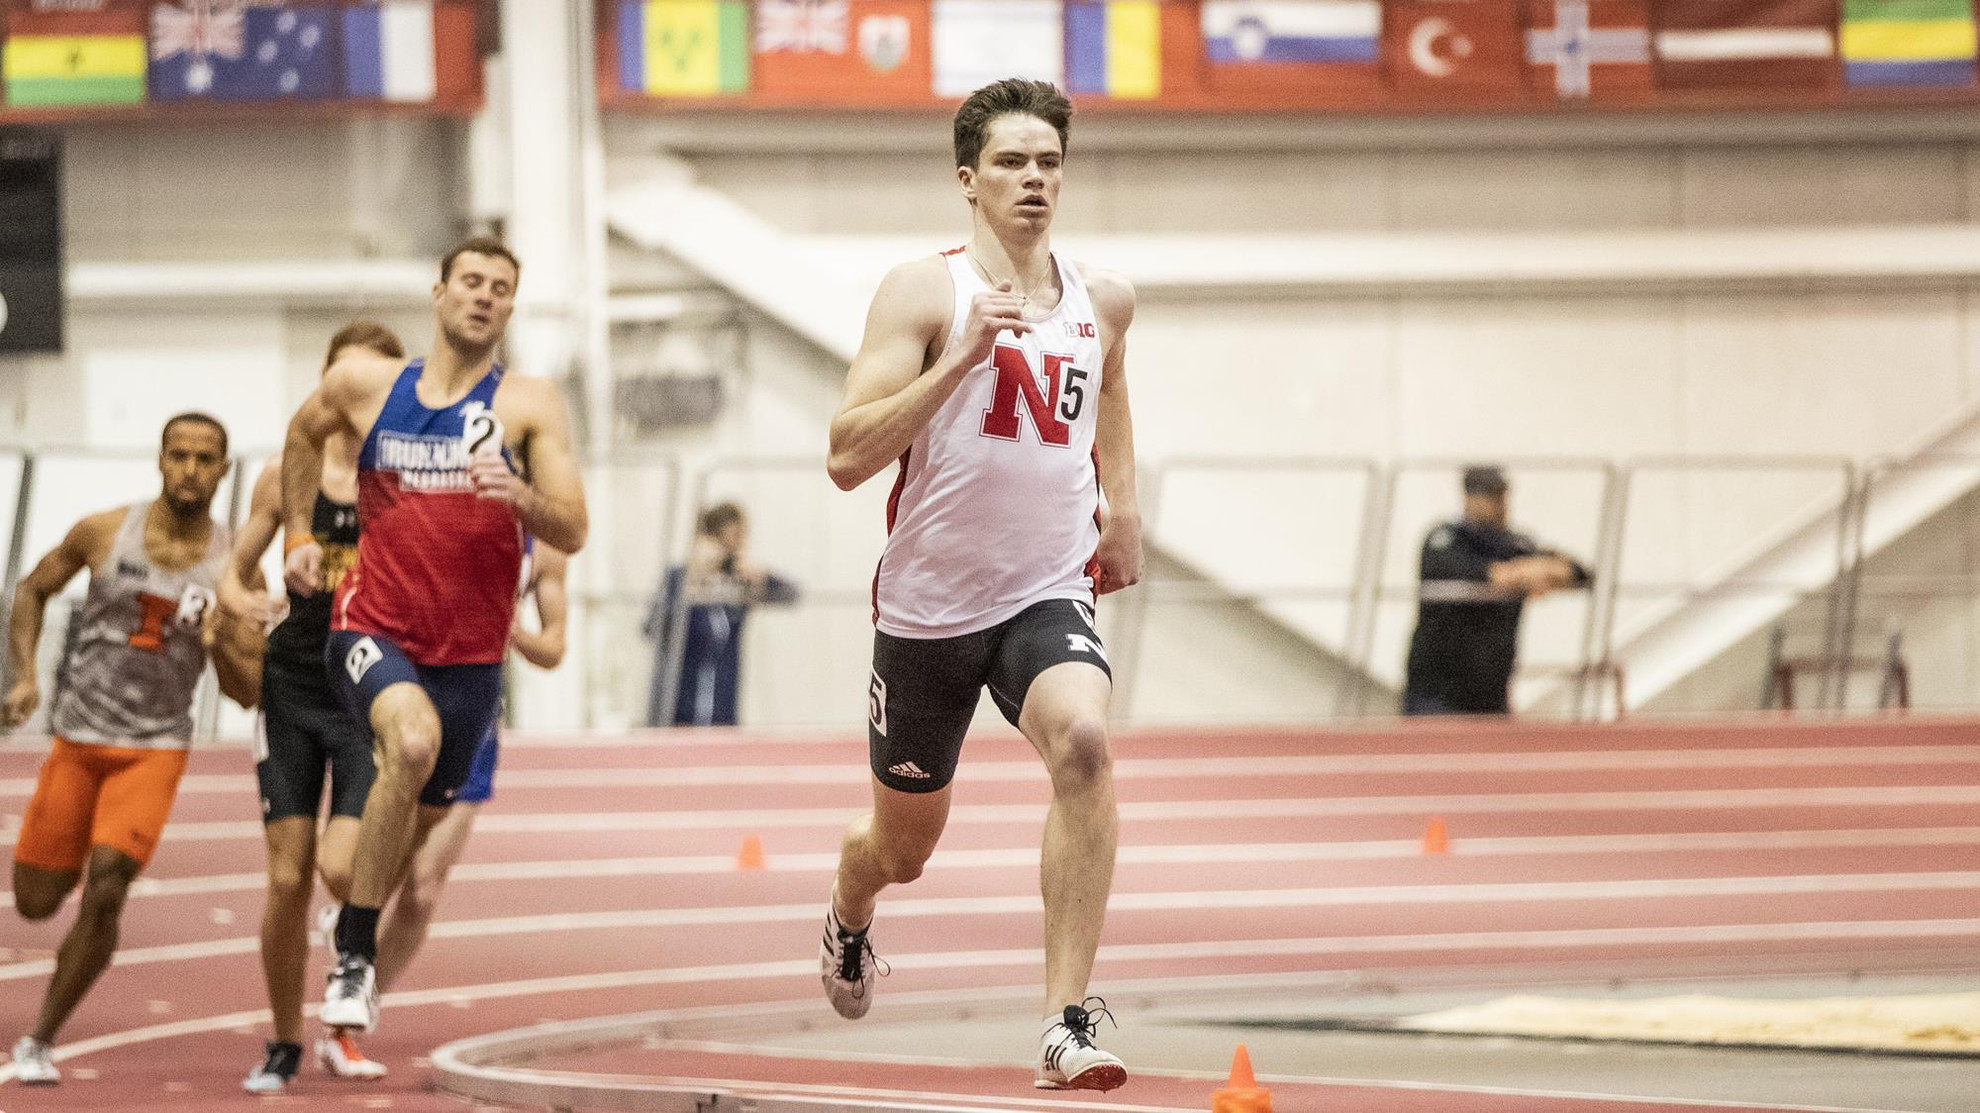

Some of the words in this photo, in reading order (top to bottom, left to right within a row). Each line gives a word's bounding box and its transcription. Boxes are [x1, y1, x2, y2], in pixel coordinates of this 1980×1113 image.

[979, 343, 1075, 448] N
[1060, 367, 1088, 420] 5
[468, 416, 495, 454] 2
[869, 672, 882, 726] 5
[888, 766, 931, 779] adidas
